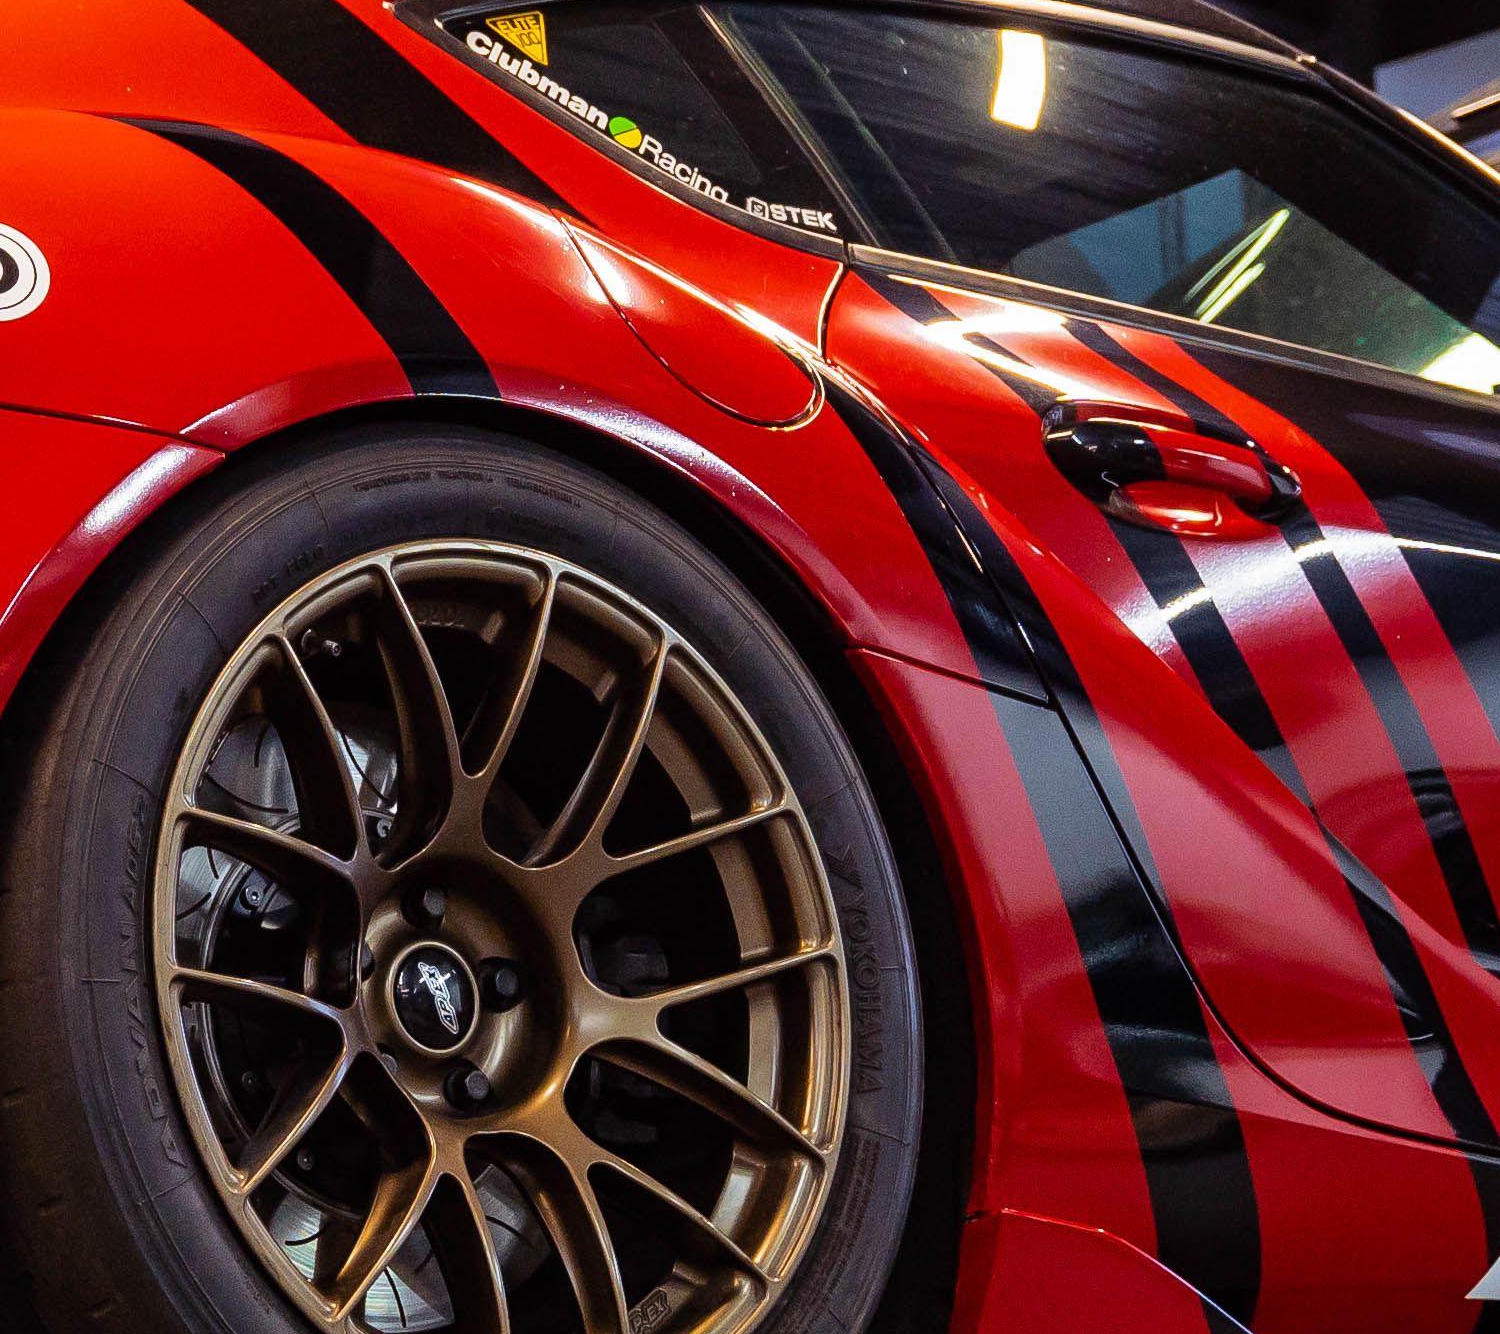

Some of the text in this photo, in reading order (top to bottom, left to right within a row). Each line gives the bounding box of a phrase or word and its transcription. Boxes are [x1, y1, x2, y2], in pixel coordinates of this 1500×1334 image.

[497, 16, 540, 34] ELITE
[466, 31, 729, 203] Clubman Racing
[769, 203, 837, 231] STEK
[842, 893, 888, 1095] YOKOHAMA
